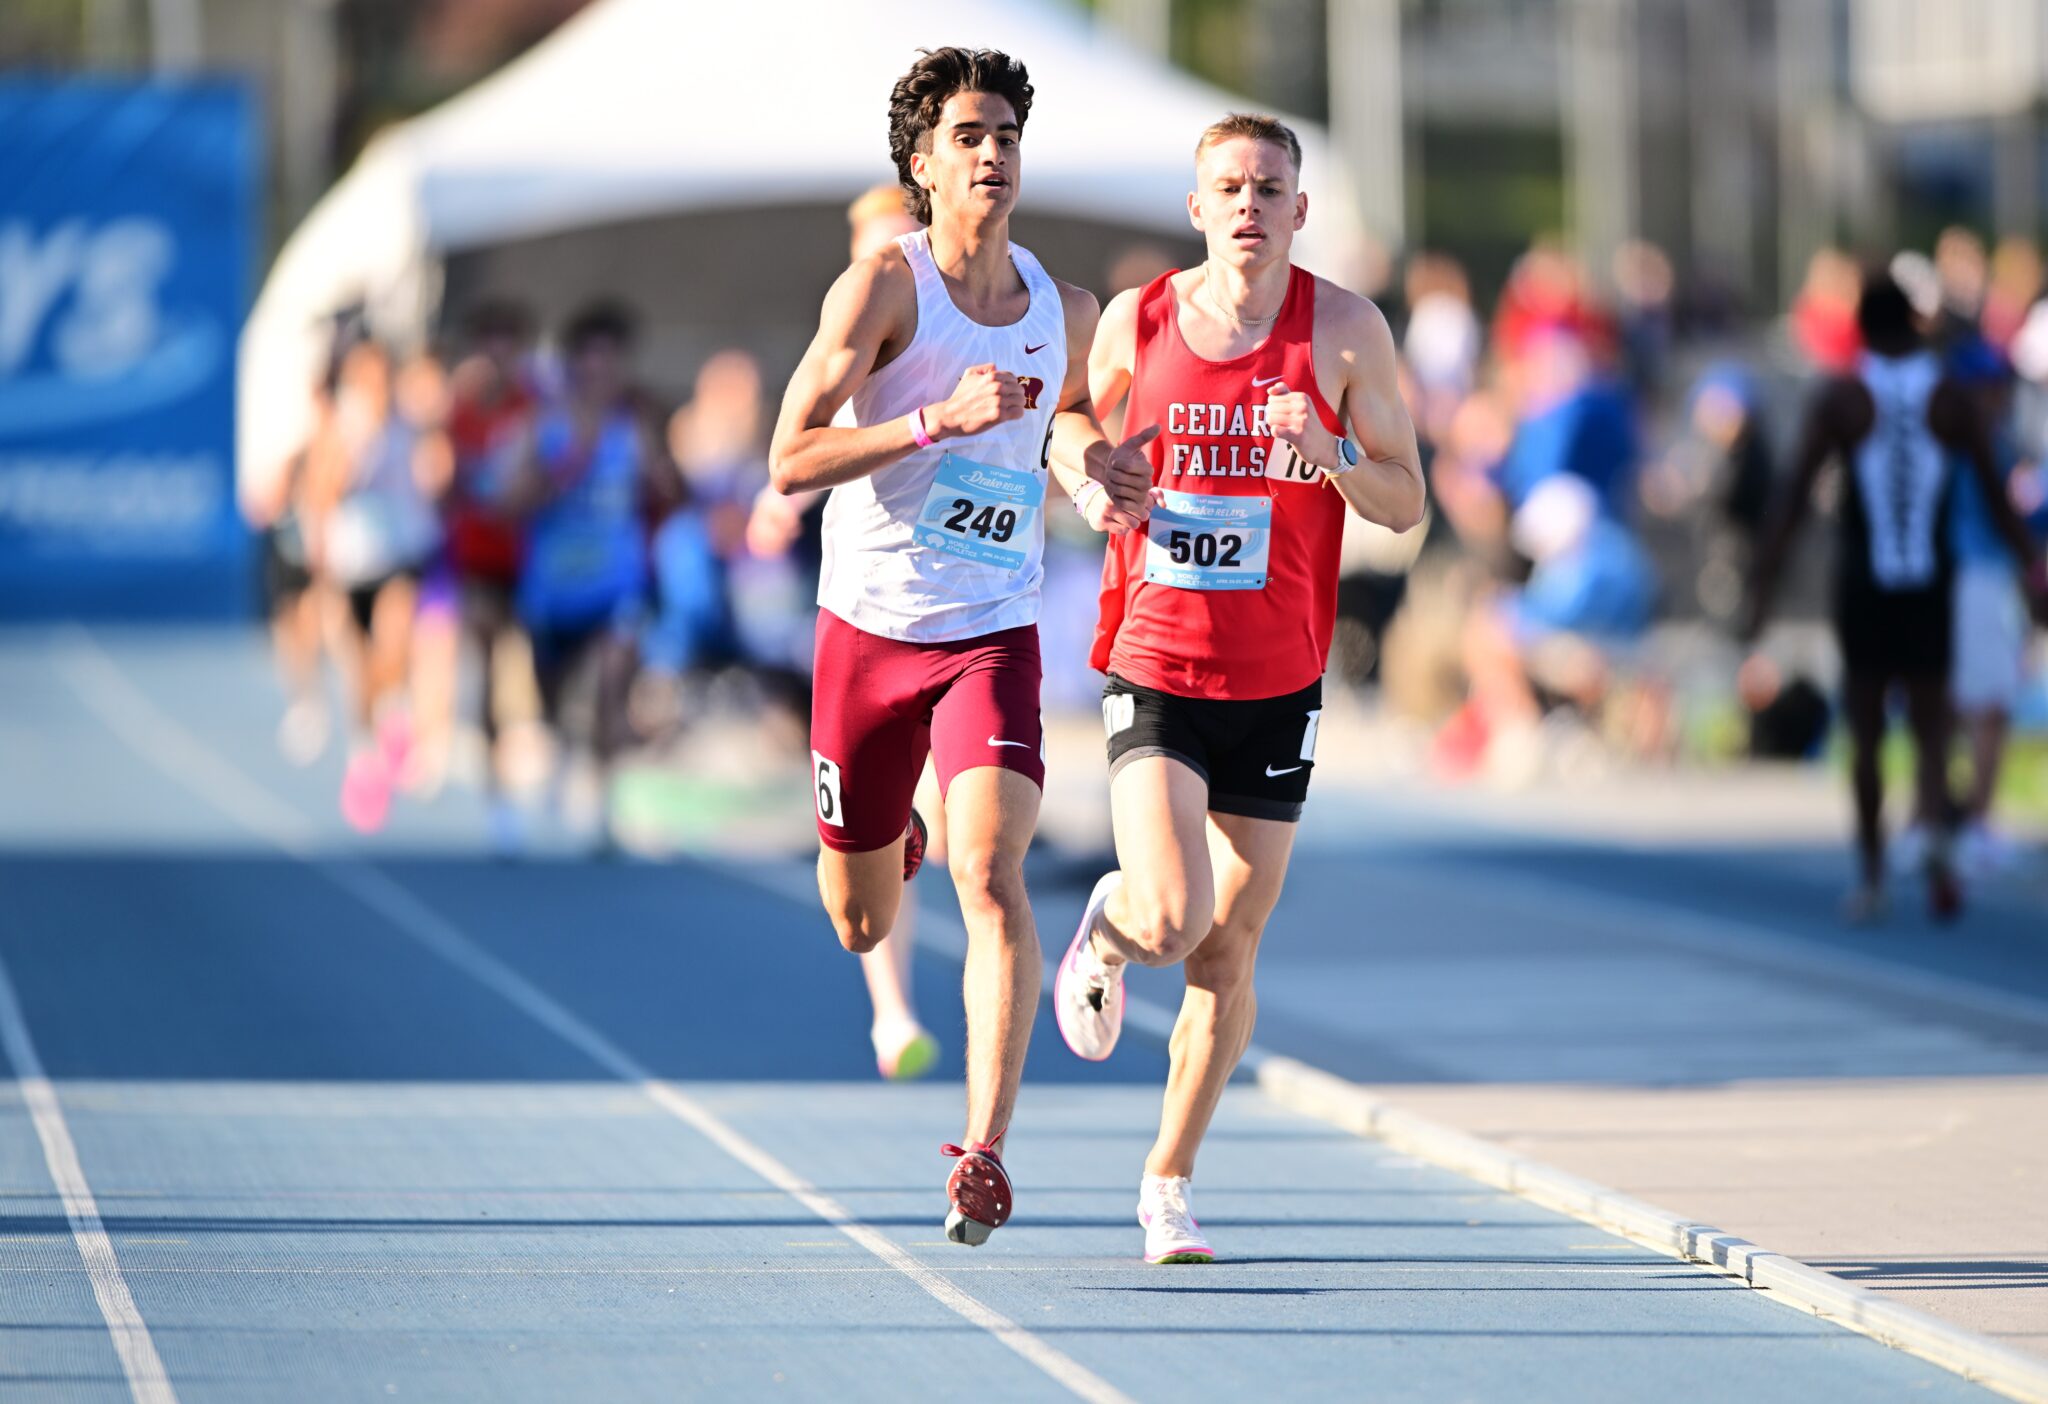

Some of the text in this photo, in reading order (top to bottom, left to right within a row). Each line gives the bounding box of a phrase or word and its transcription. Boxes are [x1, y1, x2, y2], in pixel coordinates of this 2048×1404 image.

[1168, 402, 1272, 437] CEDAR
[1172, 444, 1266, 477] FALLS
[969, 470, 1003, 489] Drake
[1178, 500, 1215, 516] Drake
[1215, 507, 1248, 519] RELAYS
[943, 498, 1017, 543] 249
[945, 545, 977, 558] ATHLETICS
[948, 539, 970, 550] WORLD
[1169, 530, 1242, 567] 502
[1176, 573, 1200, 581] WORLD
[1176, 579, 1211, 587] ATHLETICS
[818, 761, 834, 820] 6
